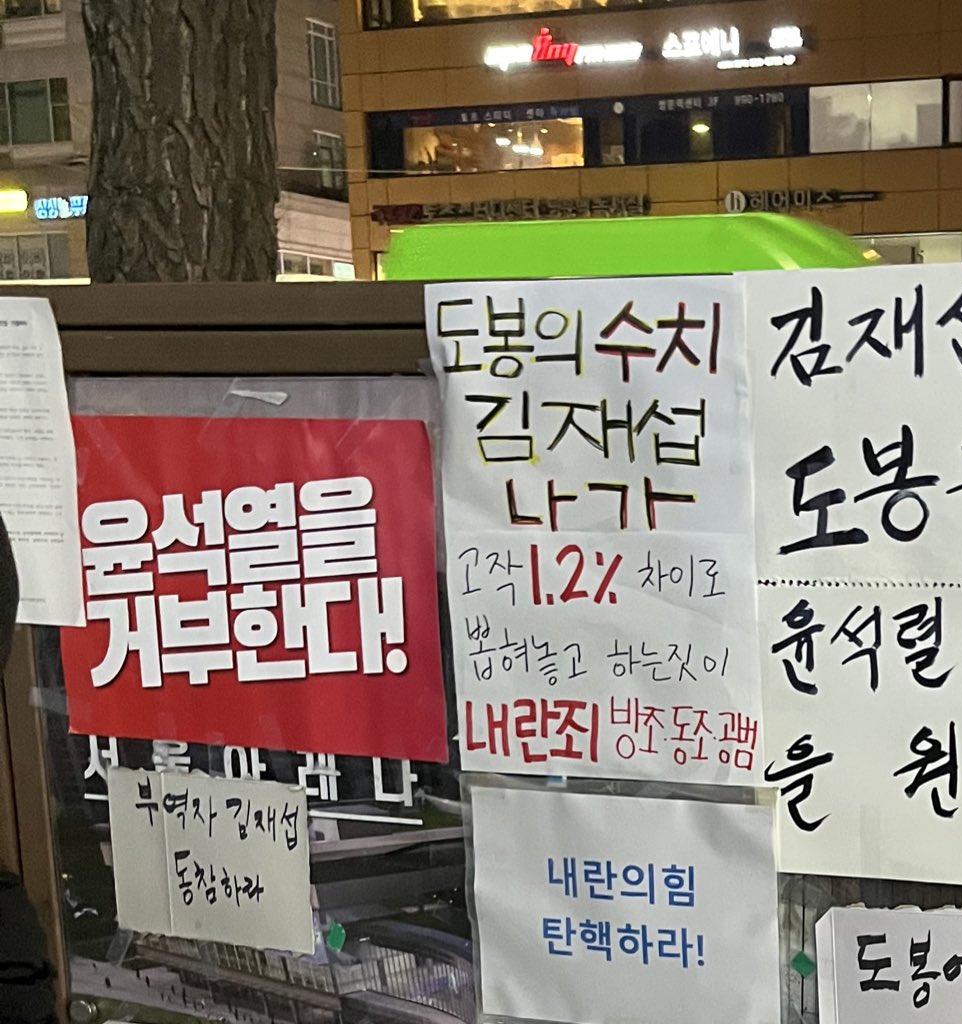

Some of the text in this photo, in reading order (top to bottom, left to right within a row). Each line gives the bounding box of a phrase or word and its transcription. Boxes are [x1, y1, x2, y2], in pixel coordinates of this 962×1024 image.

[437, 295, 721, 383] 도봉의 수치
[465, 390, 706, 467] 김재섭
[81, 475, 378, 597] 윤석열을
[506, 476, 697, 533] 나가
[458, 543, 726, 606] 고작 1.2% 차이로
[85, 576, 409, 689] 거부한다!
[771, 596, 958, 696] 윤석렬
[465, 697, 600, 763] 내란죄
[135, 775, 300, 851] 부역자 김재섭
[764, 733, 834, 832] 을
[173, 849, 265, 907] 동참하라
[547, 856, 696, 908] 내란의힘
[542, 916, 705, 969] 탄핵하라!
